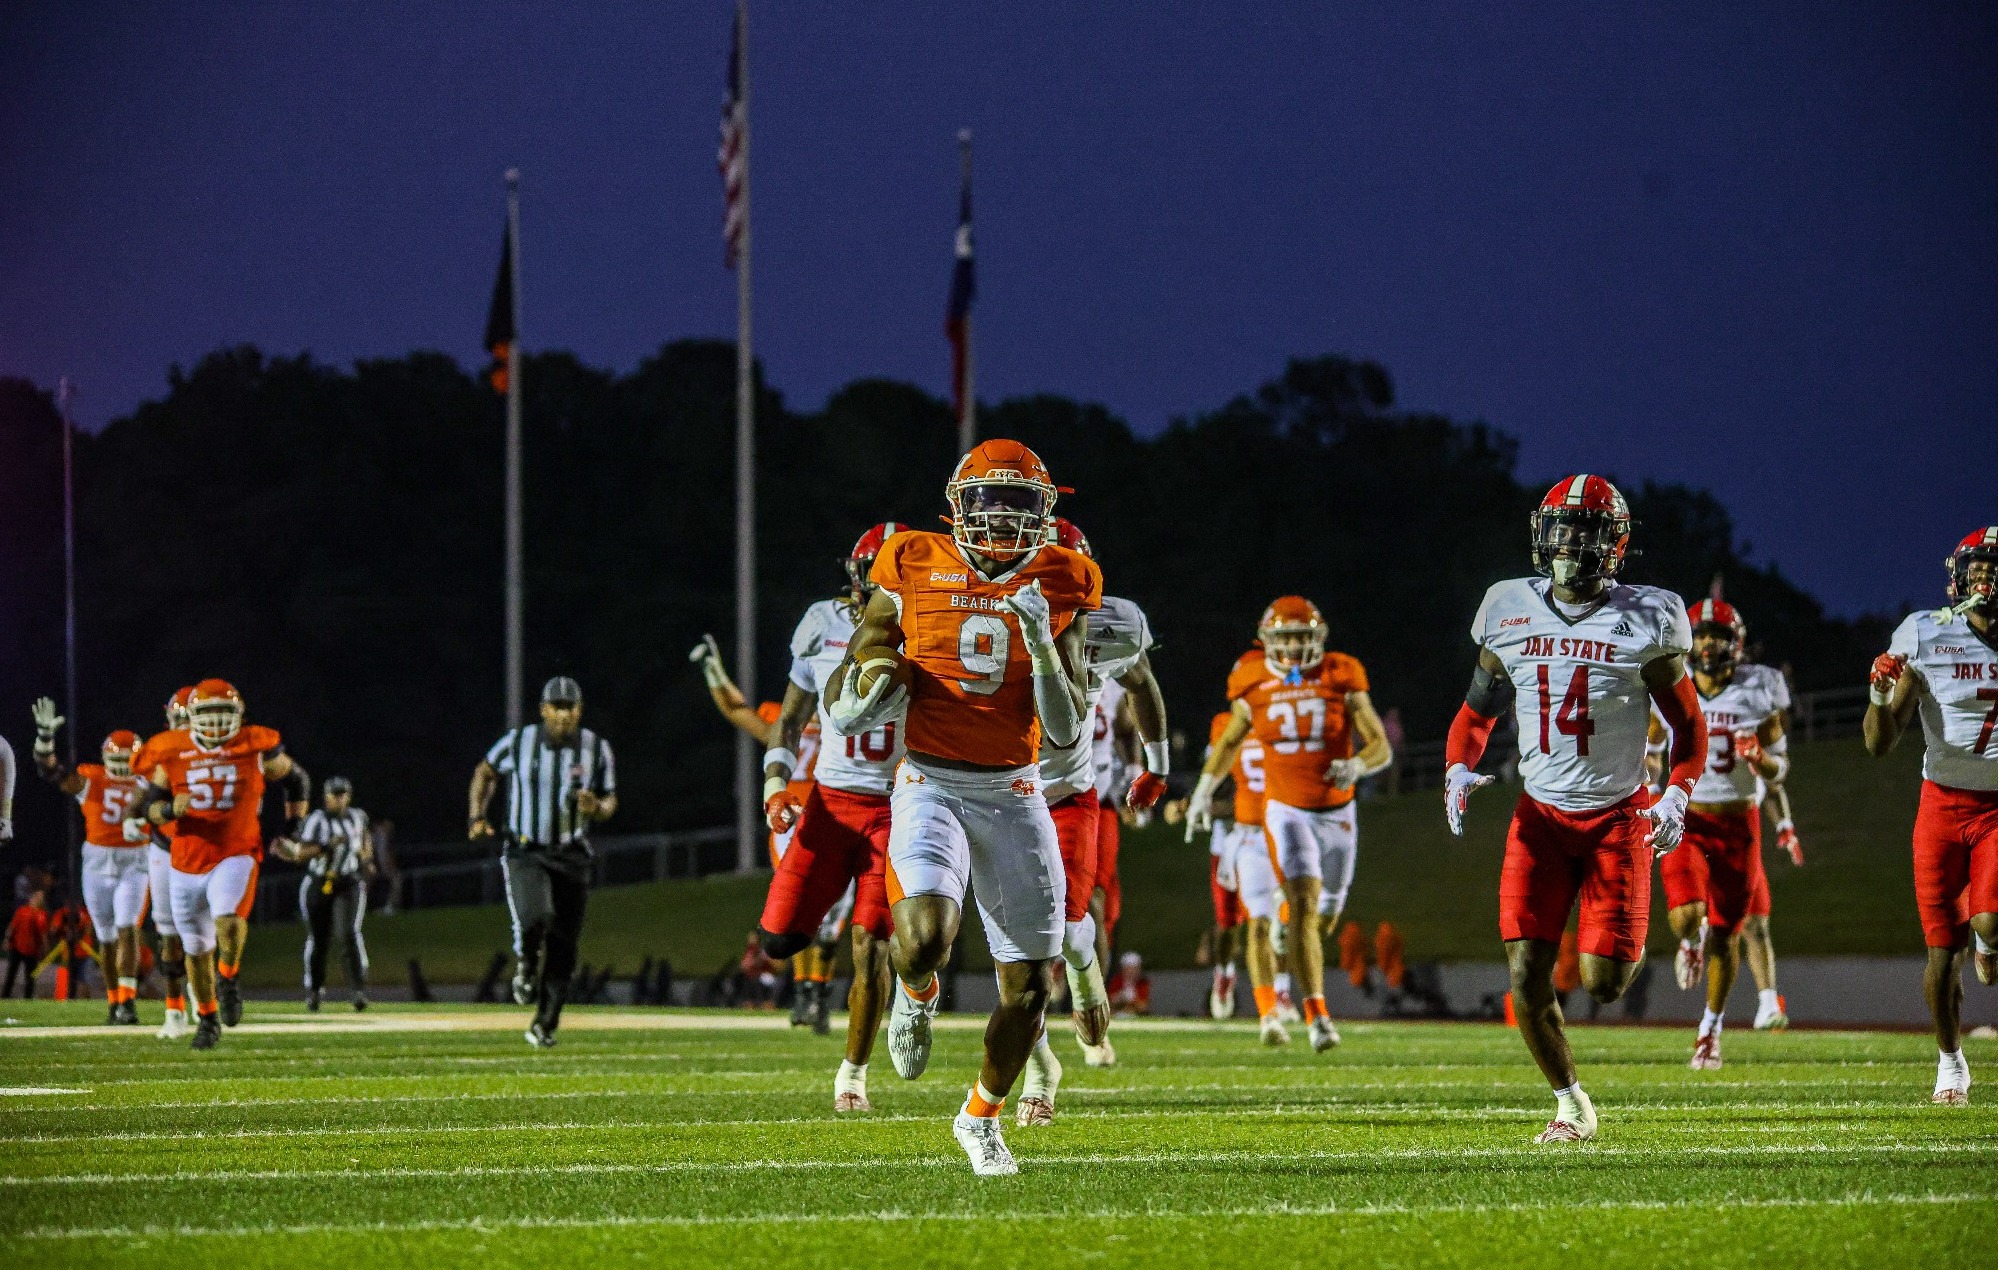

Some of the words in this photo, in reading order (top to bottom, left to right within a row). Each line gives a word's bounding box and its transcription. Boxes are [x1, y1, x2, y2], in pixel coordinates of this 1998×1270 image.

[950, 594, 1000, 610] BEARK
[958, 613, 1011, 696] 9
[1520, 637, 1555, 657] JAX
[1559, 637, 1618, 663] STATE
[1952, 663, 1984, 680] JAX
[1536, 664, 1595, 757] 14
[186, 764, 237, 811] 57
